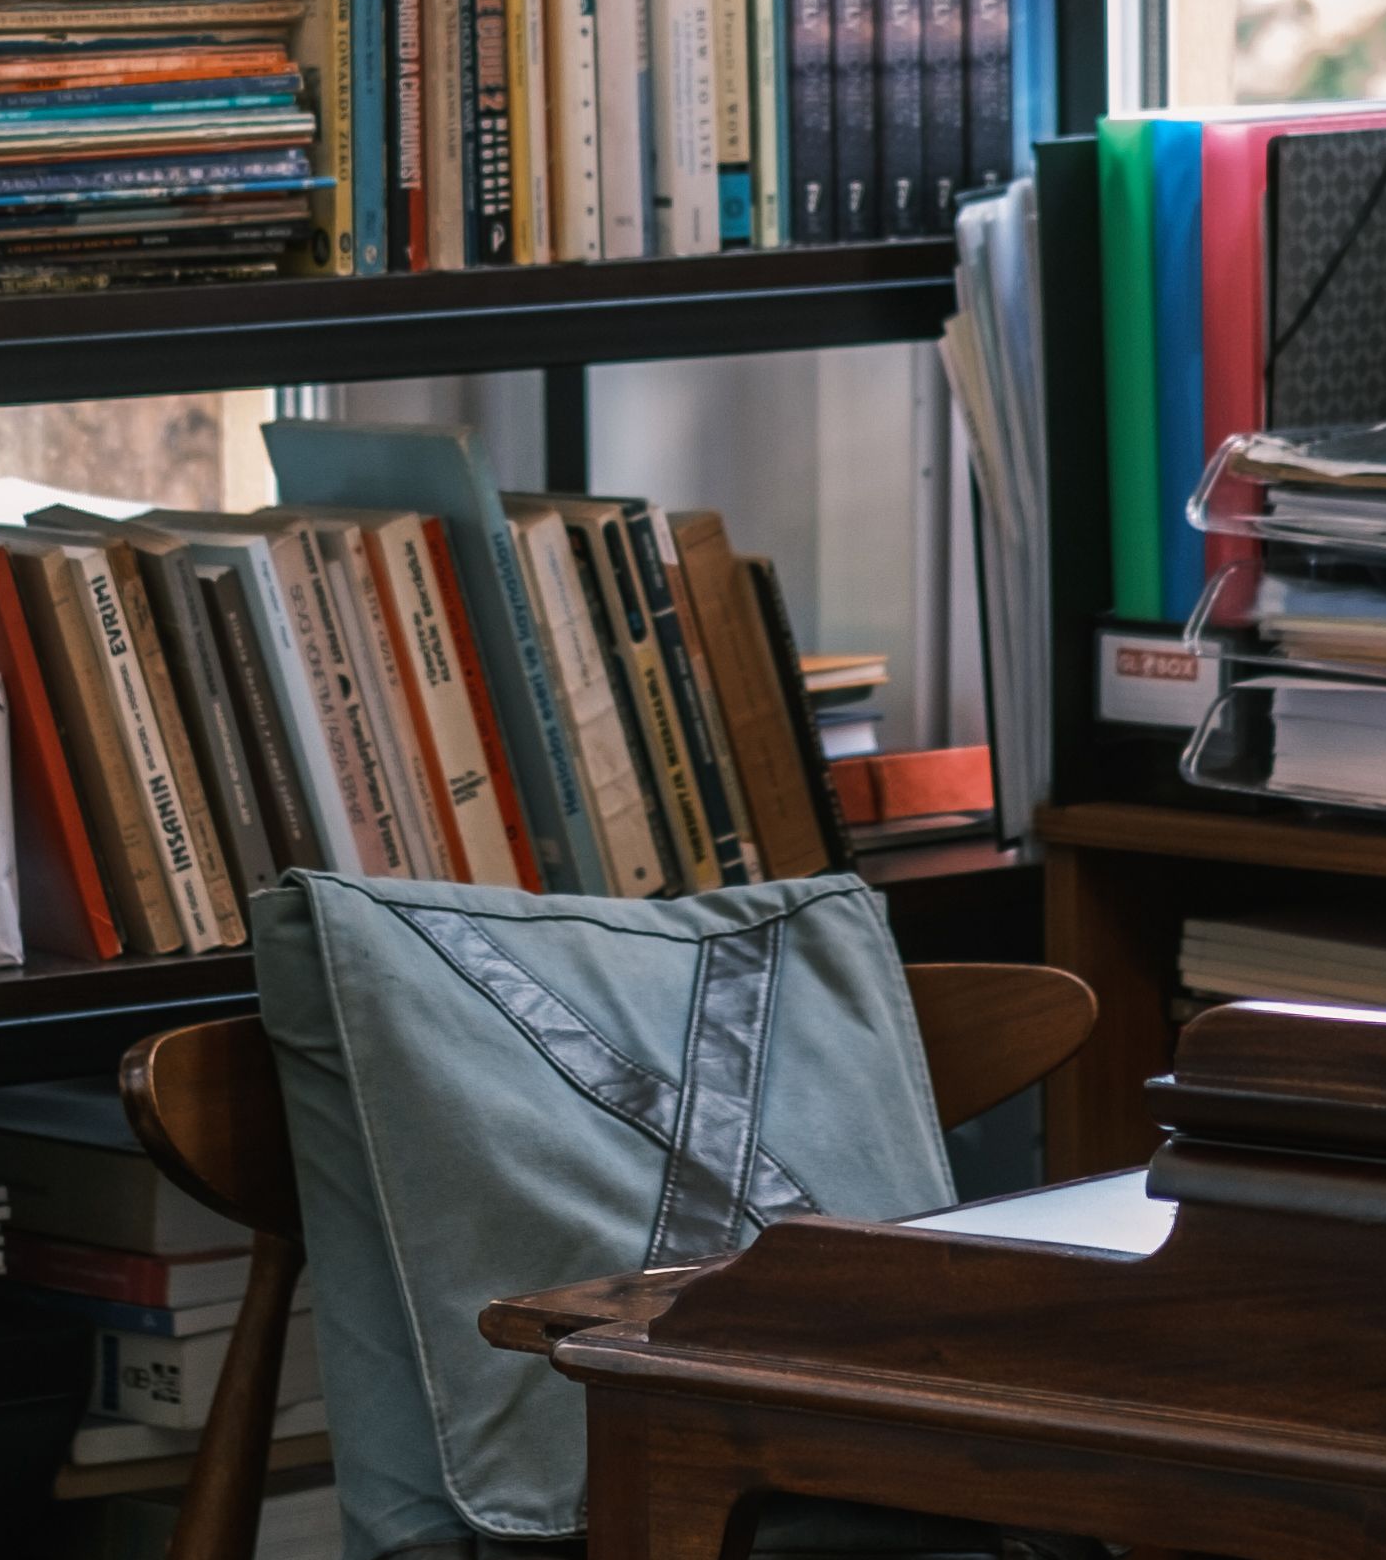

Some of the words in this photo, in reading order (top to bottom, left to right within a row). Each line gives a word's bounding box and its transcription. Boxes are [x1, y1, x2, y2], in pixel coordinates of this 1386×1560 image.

[478, 15, 504, 85] CODE
[695, 9, 708, 62] HOW
[723, 10, 738, 72] Pursuit
[337, 29, 352, 122] TOWARDS
[398, 61, 420, 78] A
[698, 79, 709, 107] TO
[725, 78, 739, 95] of
[480, 87, 505, 112] 2
[338, 131, 353, 182] ZERO
[398, 79, 421, 191] COMMUNIST
[699, 118, 712, 176] LIVE
[87, 574, 128, 656] EVRİMİ
[491, 532, 535, 640] kaynakları
[521, 644, 540, 670] ve
[530, 674, 555, 720] eseri
[547, 724, 582, 817] Hesiodos
[147, 774, 193, 875] İNSANIN
